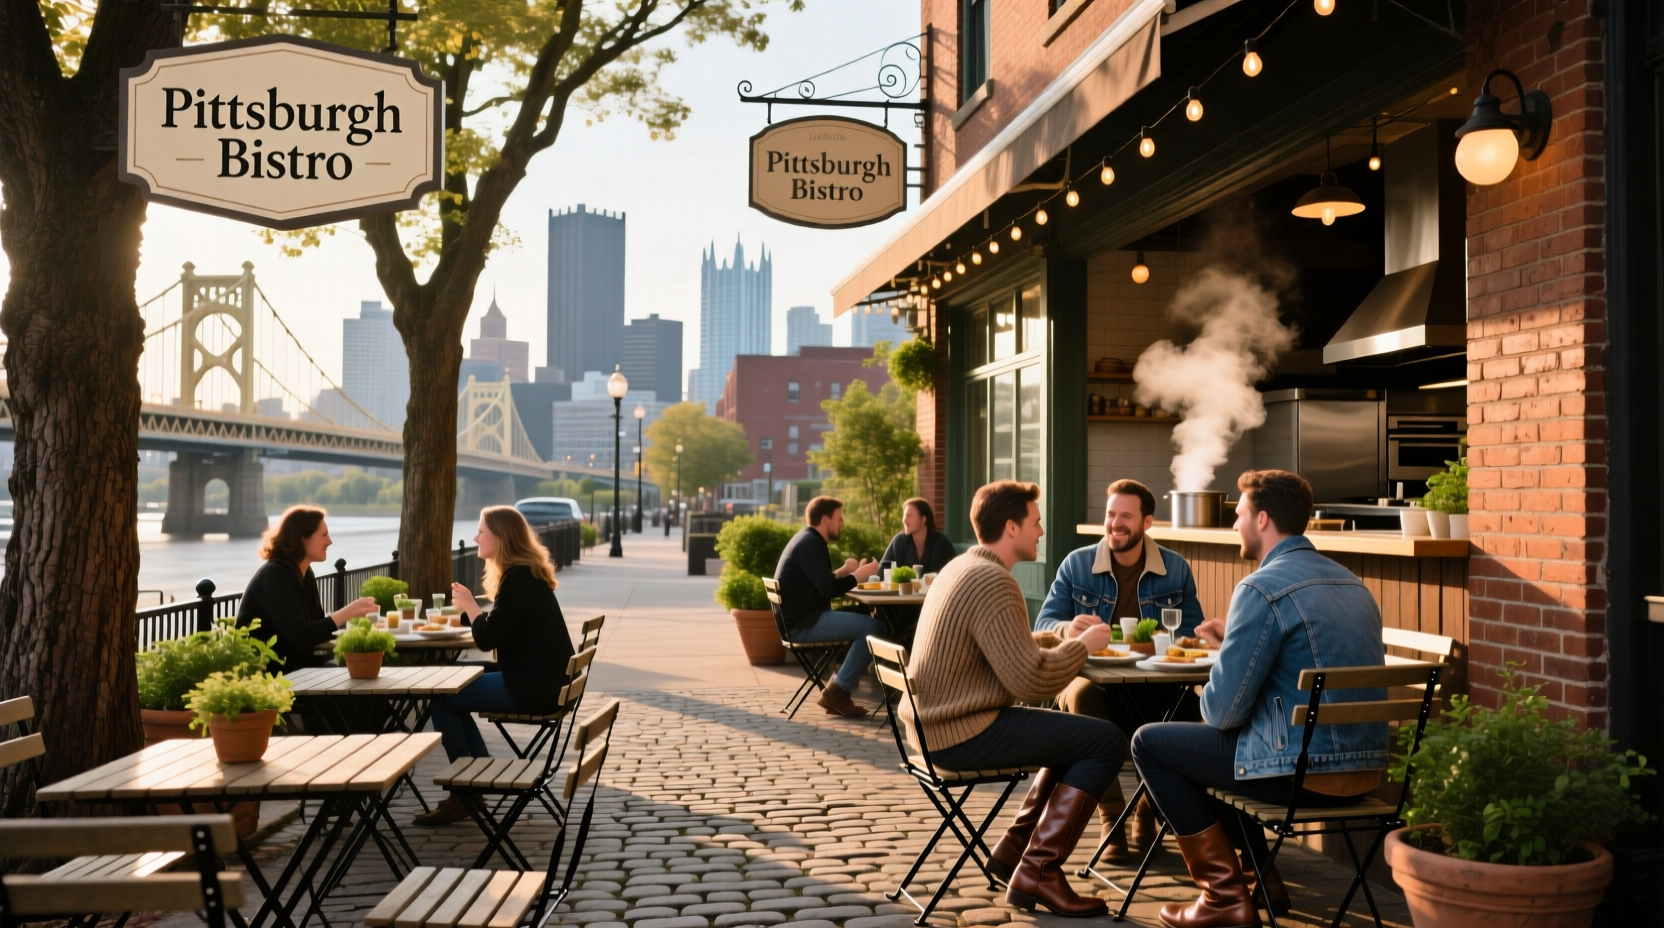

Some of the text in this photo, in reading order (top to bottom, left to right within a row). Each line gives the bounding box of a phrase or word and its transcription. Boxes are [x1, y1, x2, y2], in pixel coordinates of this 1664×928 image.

[161, 86, 403, 146] Pittsburgh
[217, 138, 353, 181] Bistro
[766, 150, 892, 184] Pittsburgh
[790, 178, 864, 202] Bistro
